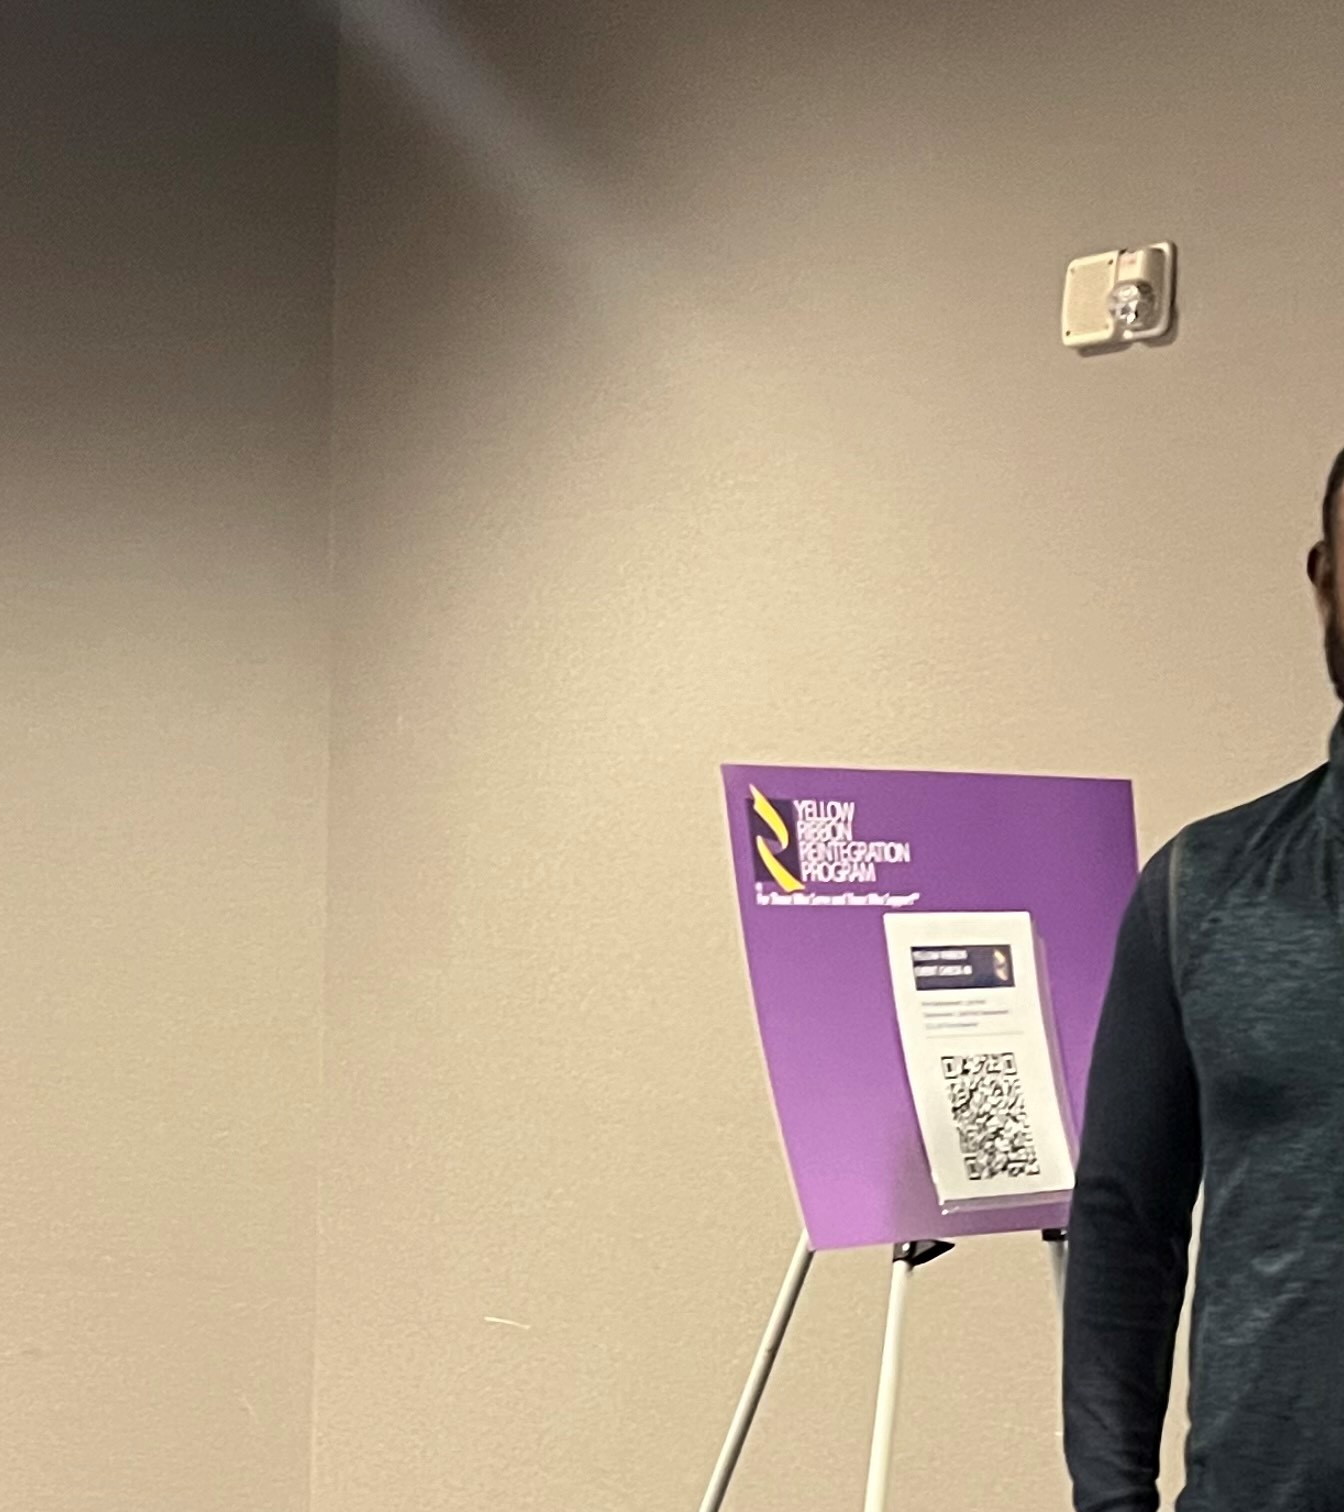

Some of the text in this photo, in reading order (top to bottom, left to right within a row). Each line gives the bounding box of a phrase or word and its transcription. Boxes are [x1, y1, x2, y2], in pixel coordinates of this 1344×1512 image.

[792, 800, 855, 821] YELLOW
[796, 820, 853, 841] RIBBON
[799, 841, 911, 862] REINTEGRATION
[802, 861, 876, 882] PROGRAM
